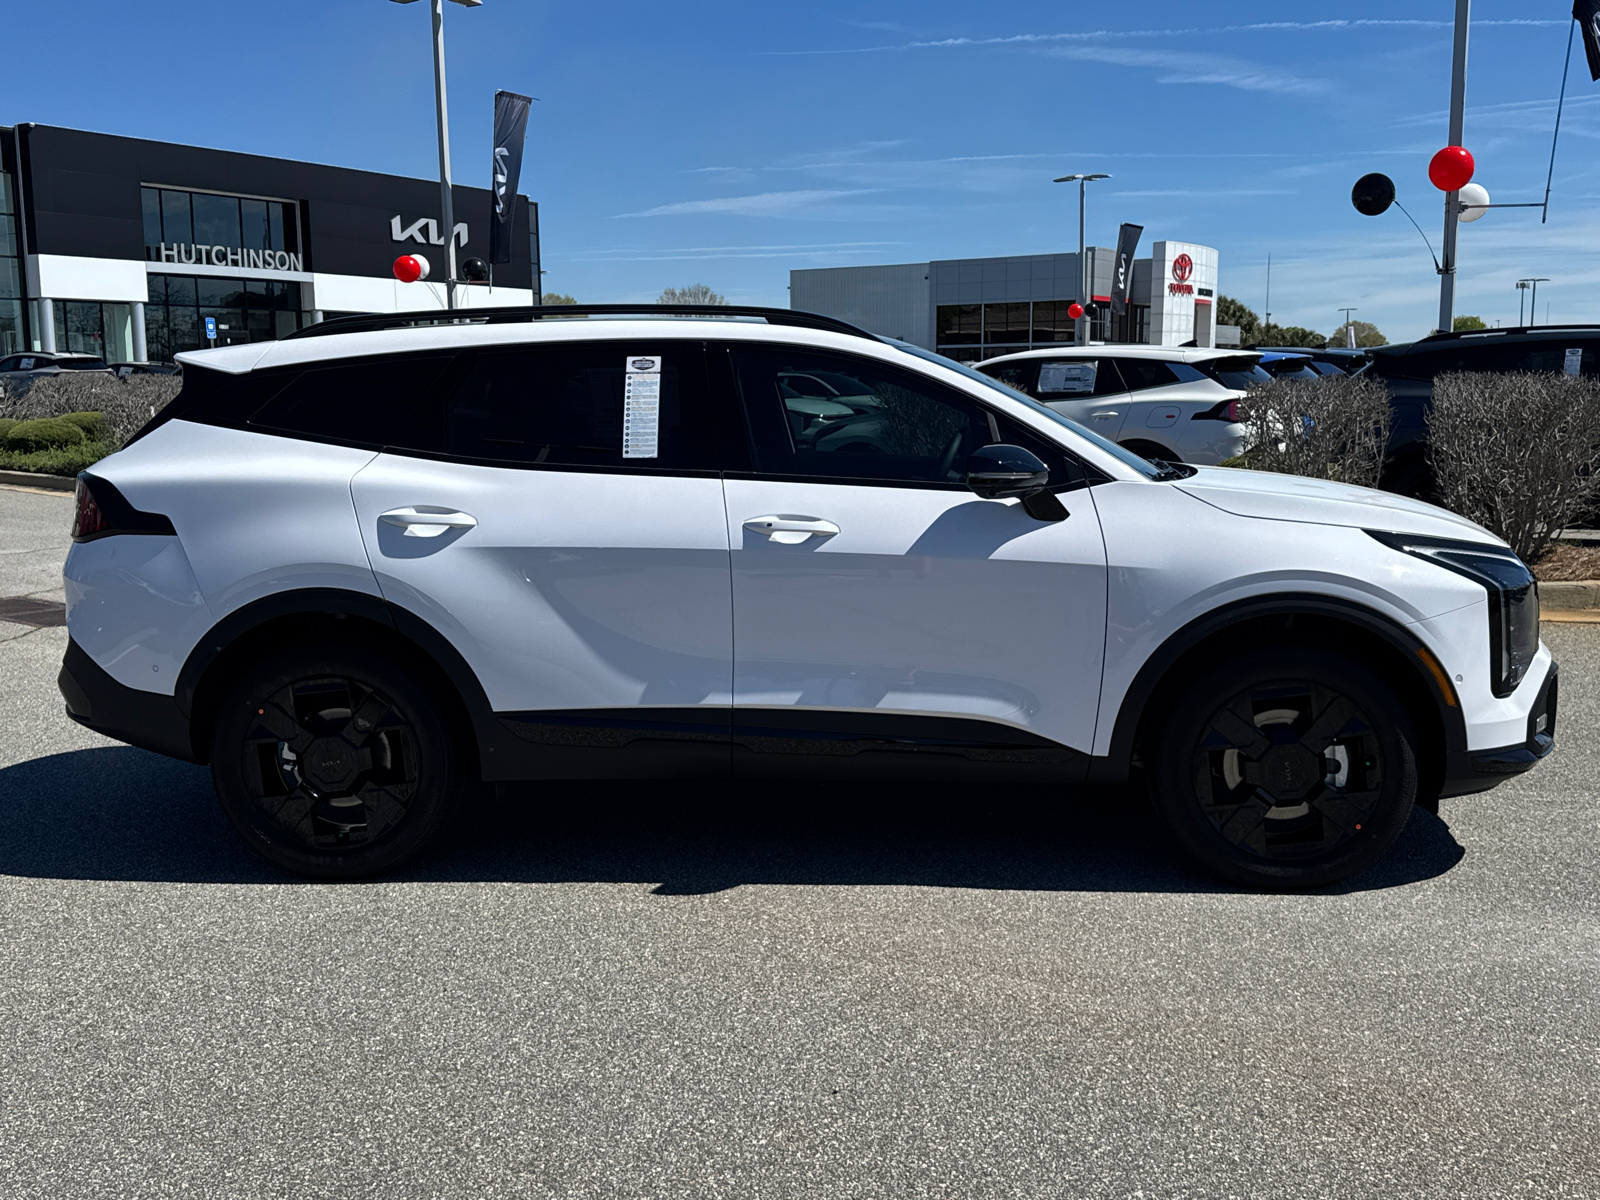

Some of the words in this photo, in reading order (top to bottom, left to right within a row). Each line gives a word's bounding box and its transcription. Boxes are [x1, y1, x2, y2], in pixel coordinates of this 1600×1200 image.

[495, 147, 509, 214] KIA
[391, 215, 469, 248] KIA
[160, 242, 303, 272] HUTCHINSON
[1169, 282, 1194, 295] TOYOTA
